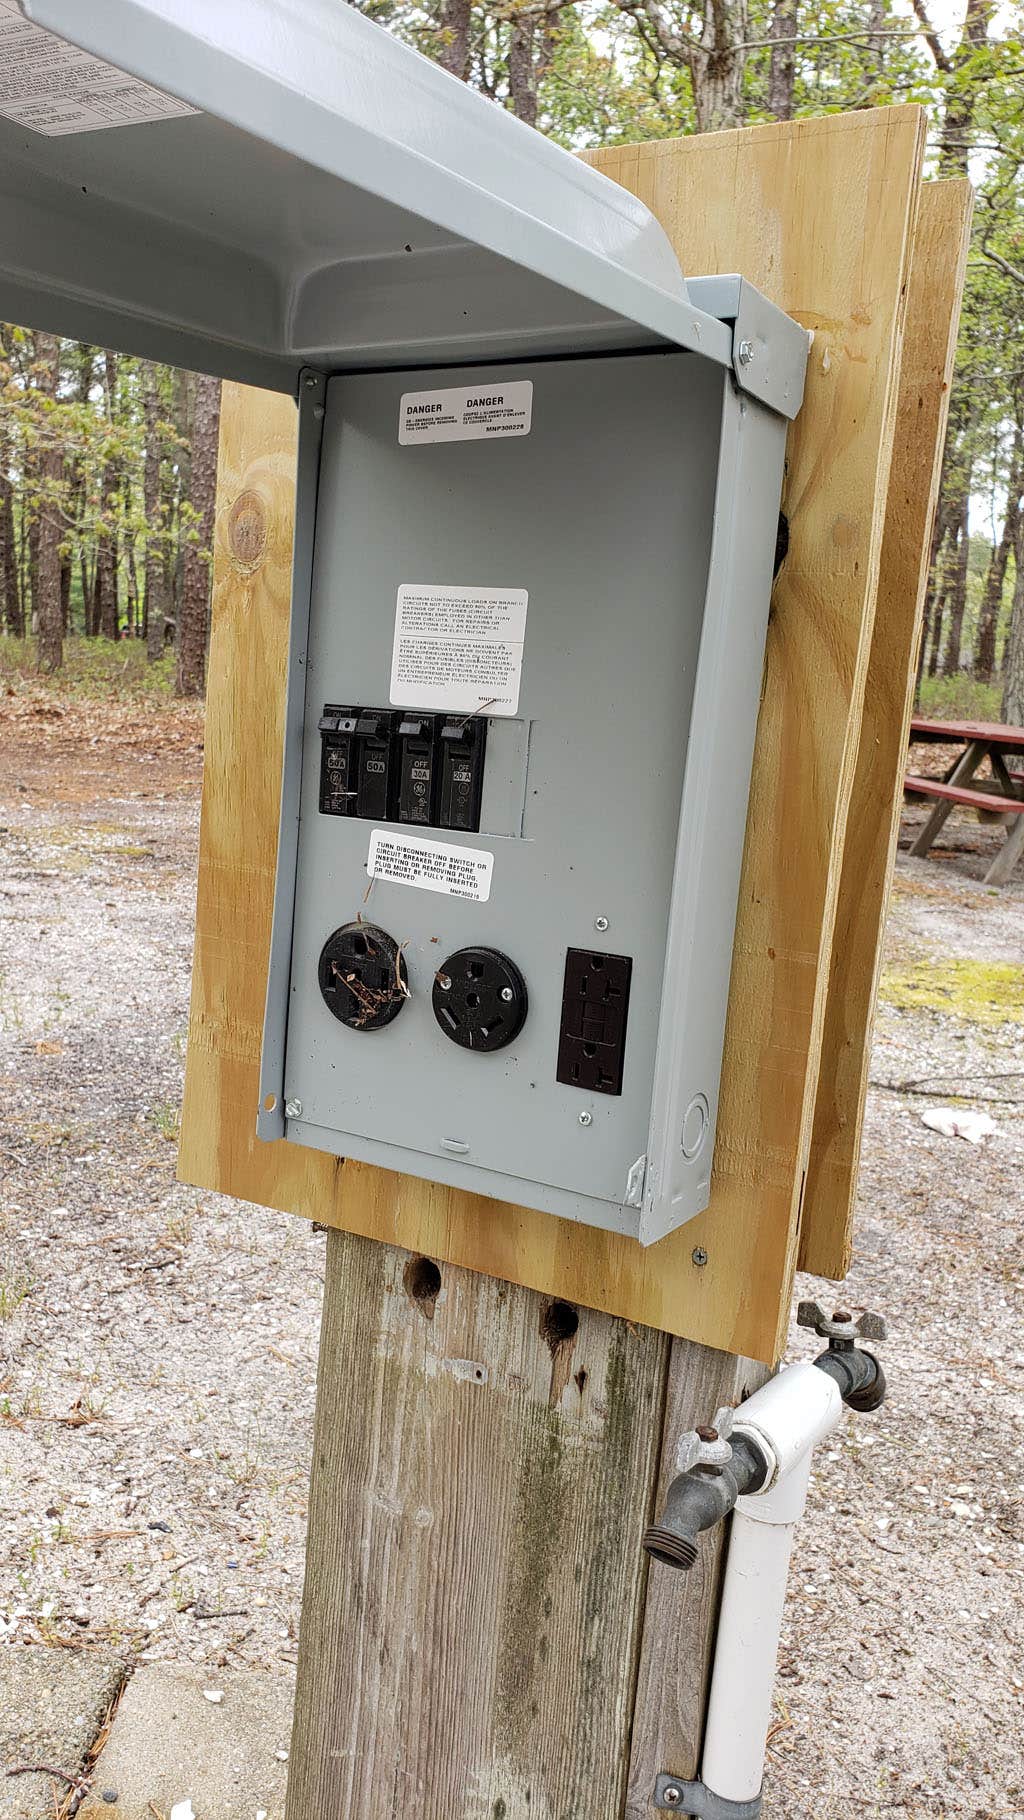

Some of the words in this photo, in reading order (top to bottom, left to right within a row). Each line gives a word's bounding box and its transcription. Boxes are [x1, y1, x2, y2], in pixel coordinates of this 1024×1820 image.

[466, 397, 504, 408] DANGER
[407, 403, 442, 415] DANGER
[329, 759, 345, 768] 50A
[368, 762, 384, 772] 50A
[414, 760, 428, 769] OFF
[459, 764, 470, 772] OFF
[414, 769, 428, 779] 30A
[377, 841, 394, 850] TURN
[396, 845, 448, 862] DISCONNECTING
[449, 857, 475, 868] SWITCH
[376, 847, 401, 858] CIRCUIT
[403, 853, 432, 865] BREAKER
[434, 860, 446, 868] OFF
[448, 864, 474, 874] BEFORE
[374, 866, 383, 874] OR
[375, 854, 409, 866] INSERTING
[422, 864, 456, 877] REMOVING
[458, 872, 478, 882] PLUG.
[375, 860, 392, 869] PLUG
[393, 864, 411, 874] MUST
[423, 871, 444, 881] FULLY
[446, 876, 479, 889] INSERTED
